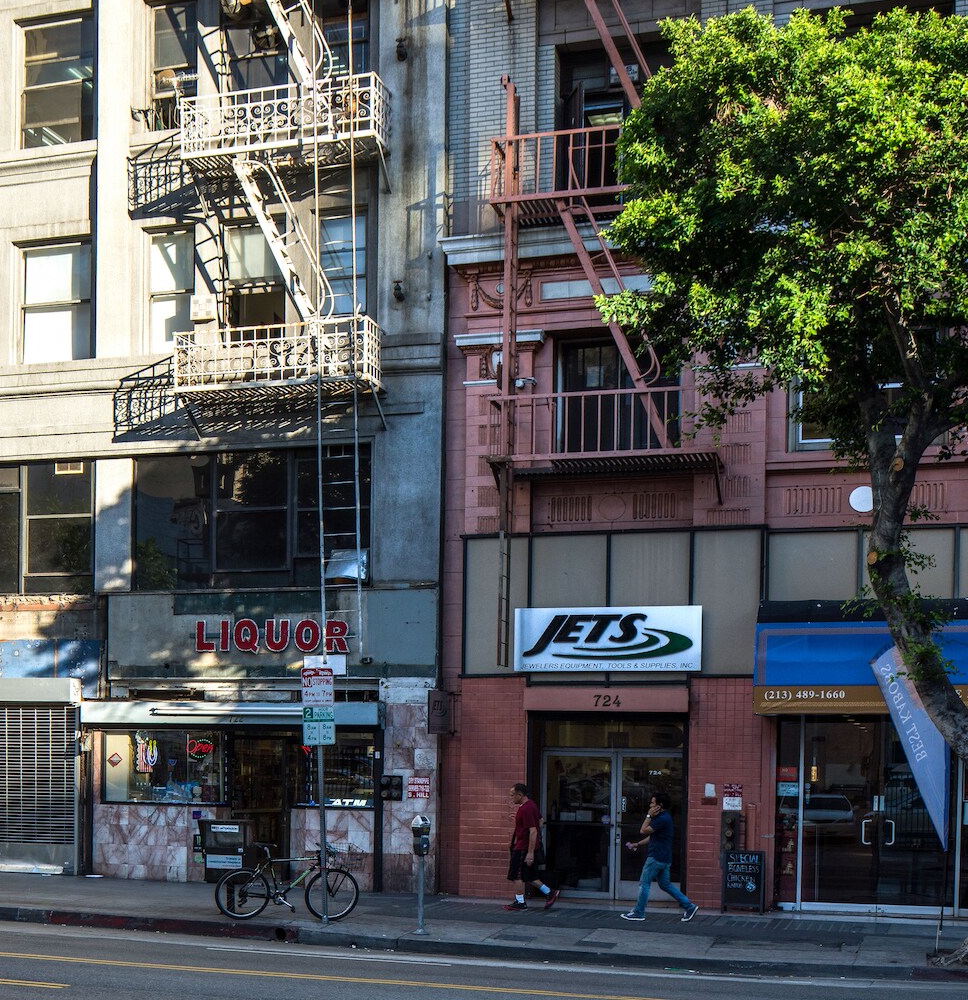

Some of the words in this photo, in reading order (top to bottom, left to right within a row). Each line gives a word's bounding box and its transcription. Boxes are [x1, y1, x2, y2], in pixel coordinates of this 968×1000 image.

[195, 618, 350, 654] LIQUOR
[522, 613, 648, 657] JETS
[521, 662, 559, 670] JEWELERS
[302, 677, 312, 687] NO
[312, 678, 332, 686] STOPPING
[764, 690, 792, 700] (213)
[795, 690, 845, 699] 489-1660
[593, 694, 622, 707] 724
[305, 708, 312, 718] 2
[186, 739, 214, 754] Open
[330, 798, 368, 807] ATM
